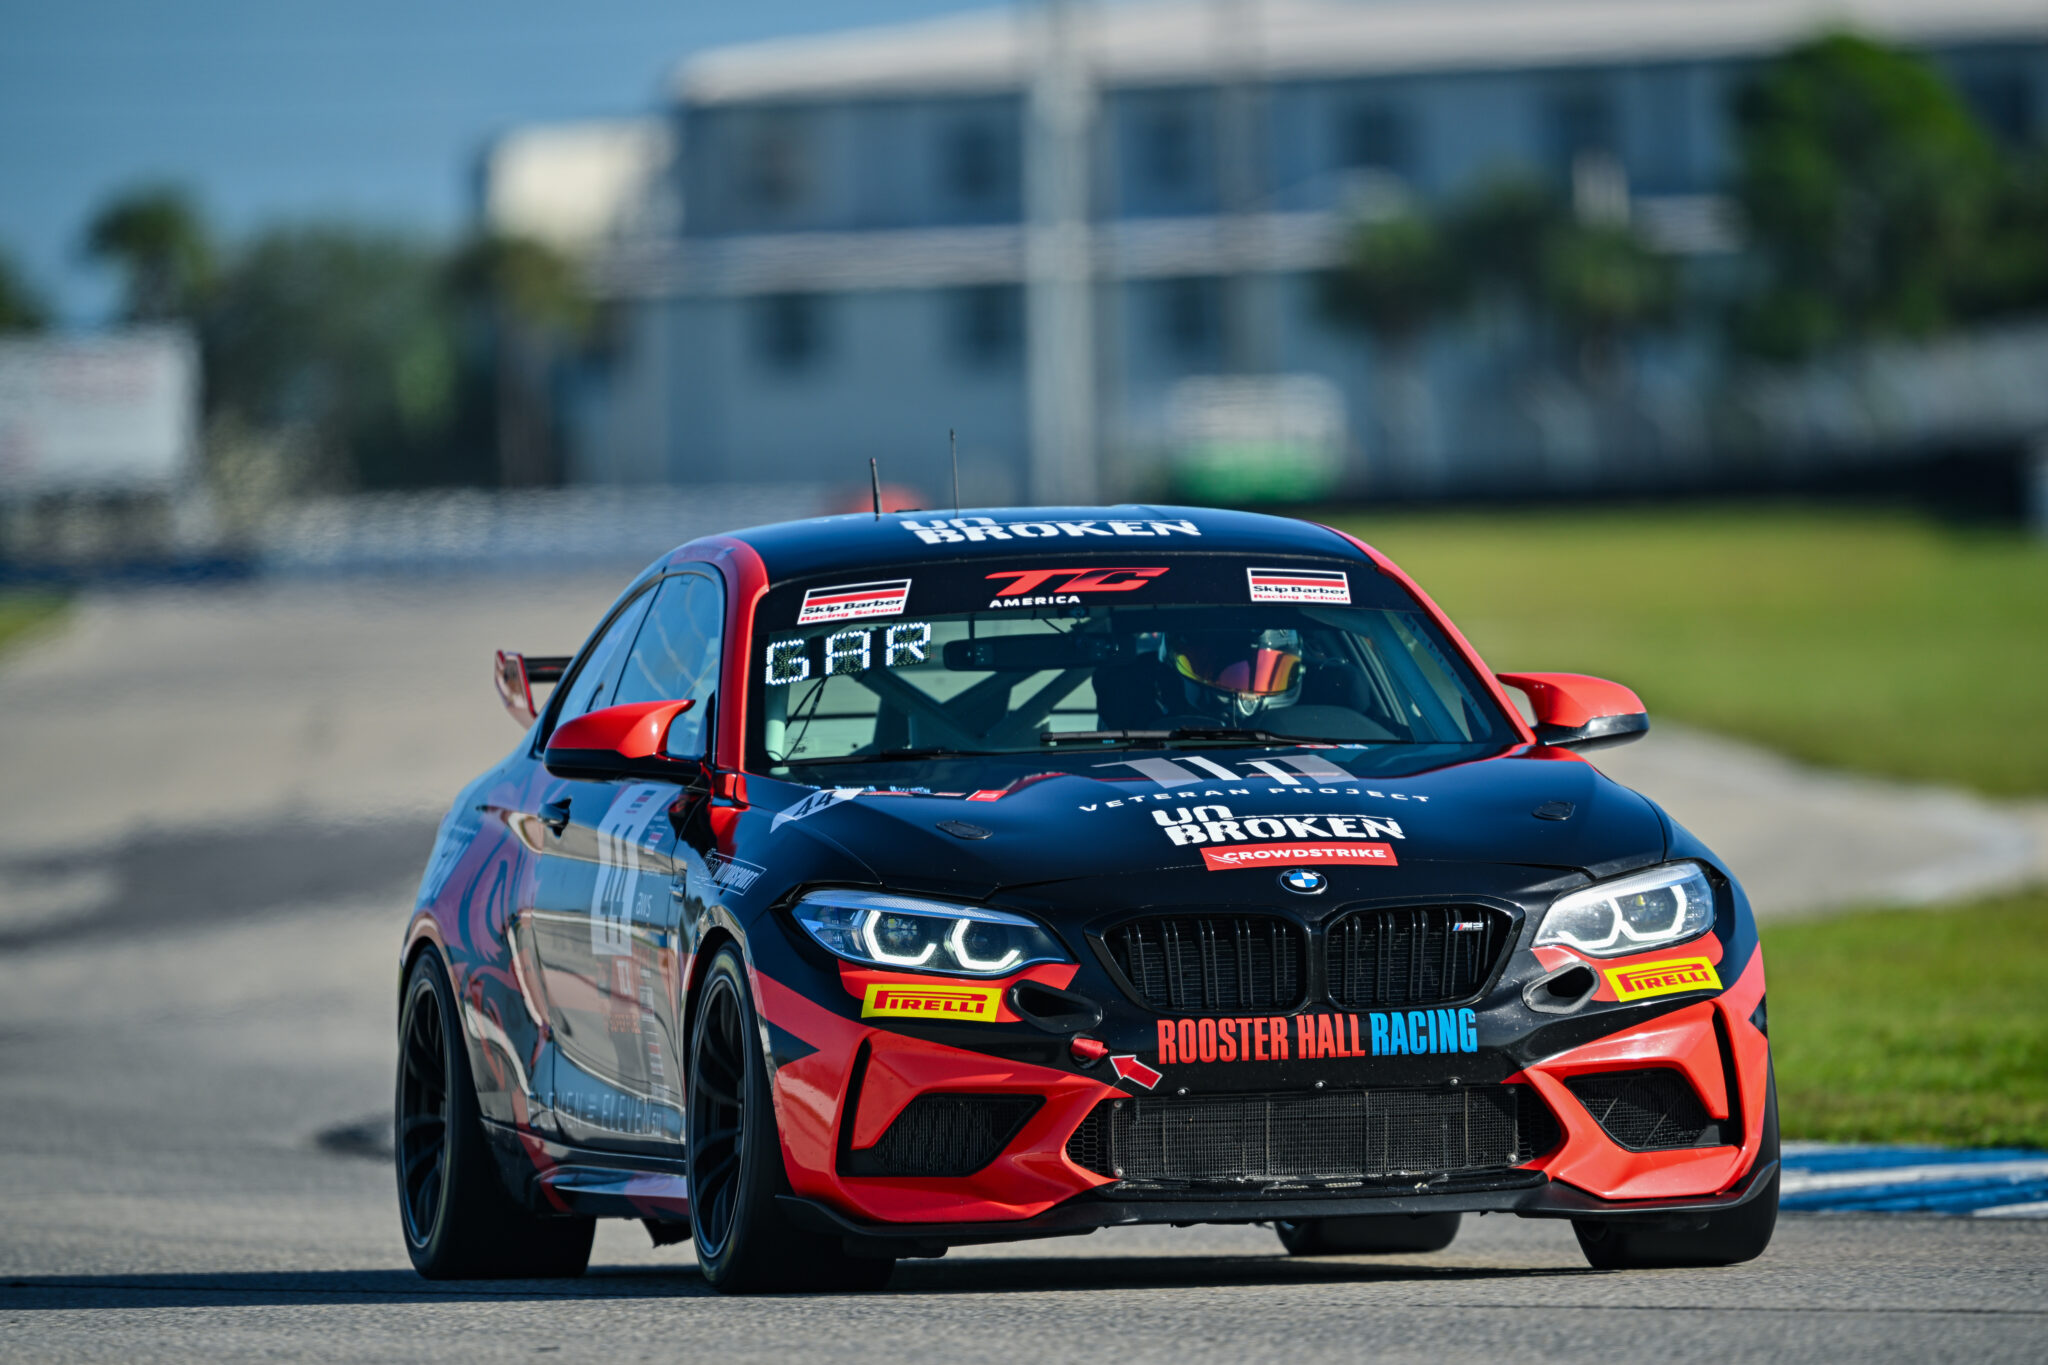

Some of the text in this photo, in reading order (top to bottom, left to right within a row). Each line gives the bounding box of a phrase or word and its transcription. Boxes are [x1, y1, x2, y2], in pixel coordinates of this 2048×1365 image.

[914, 520, 1202, 544] BROKEN
[985, 567, 1170, 596] TC
[1291, 586, 1346, 595] Barber
[800, 606, 902, 622] Racing School
[803, 599, 903, 616] Skip Barber
[989, 596, 1081, 608] AMERICA
[765, 621, 931, 685] GAR
[1078, 787, 1431, 812] VETERAN PROJECT
[1163, 817, 1406, 846] BROKEN
[1222, 848, 1387, 861] CROWDSTRIKE
[1616, 963, 1711, 993] PIRELLI
[873, 990, 988, 1014] PIRELLI
[1157, 1008, 1478, 1065] ROOSTER HALL RACING
